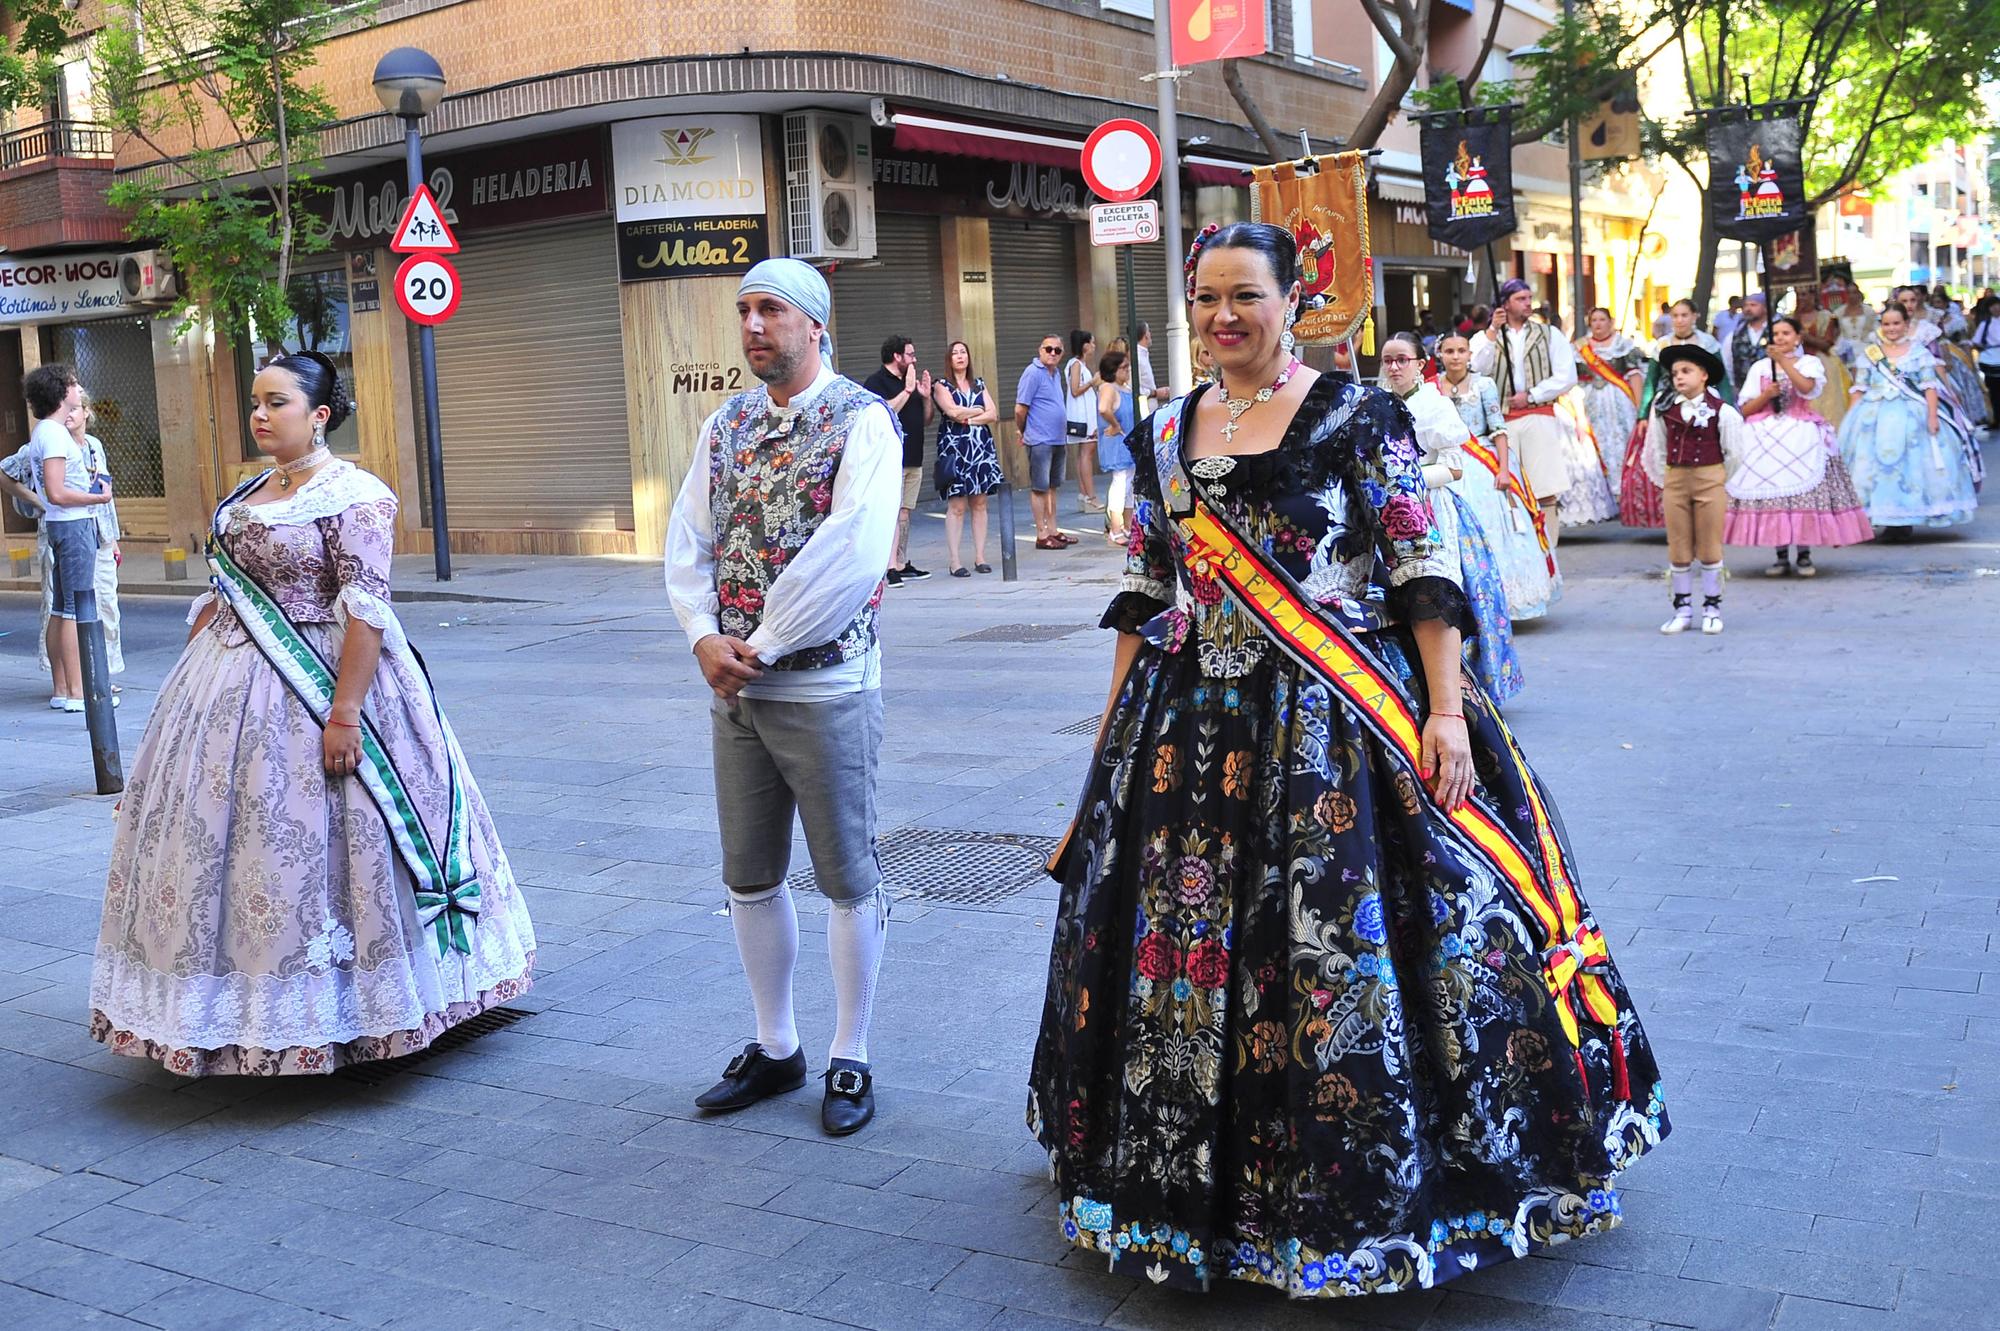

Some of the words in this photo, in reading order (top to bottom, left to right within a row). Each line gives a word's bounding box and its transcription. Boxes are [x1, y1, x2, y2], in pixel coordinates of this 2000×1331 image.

[472, 158, 592, 205] HELADERIA
[624, 179, 755, 206] DIAMOND
[986, 160, 1078, 213] Mila
[1098, 212, 1150, 223] BICICLETAS
[1103, 205, 1144, 215] EXCEPTO
[626, 220, 685, 237] CAFETERÍA
[693, 217, 759, 232] HELADERÍA
[1139, 225, 1151, 234] 10
[637, 238, 729, 269] Mila
[732, 236, 749, 263] 2
[410, 277, 447, 301] 20
[672, 371, 725, 394] Mila
[727, 367, 742, 390] 2
[230, 577, 278, 632] DAMA
[274, 635, 306, 668] DE
[1220, 547, 1387, 714] BELLEZA
